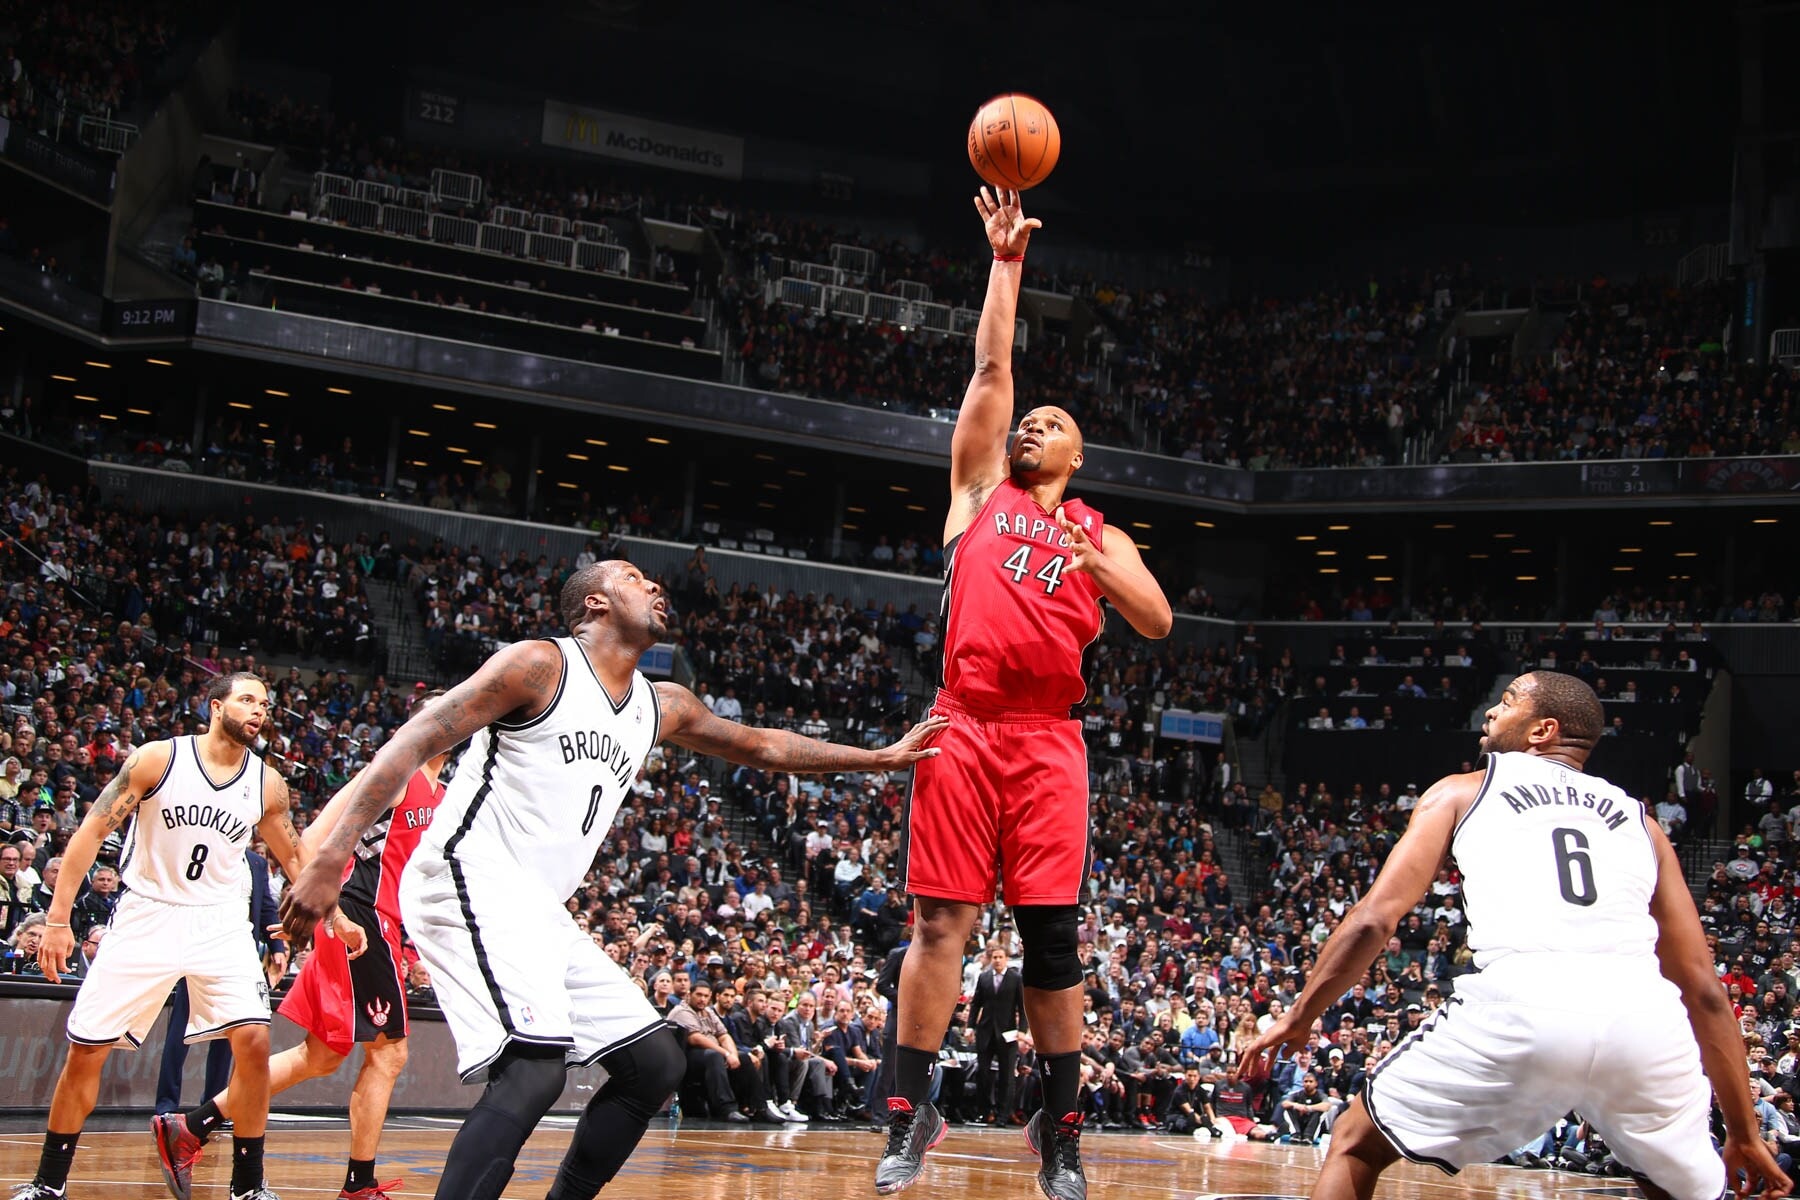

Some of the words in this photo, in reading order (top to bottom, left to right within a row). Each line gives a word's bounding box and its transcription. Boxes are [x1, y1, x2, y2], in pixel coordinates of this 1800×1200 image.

[420, 102, 455, 123] 212
[606, 127, 724, 168] McDonald's
[121, 310, 151, 325] 9:12
[153, 309, 175, 324] PM
[1631, 465, 1640, 477] 2
[994, 511, 1070, 549] RAPTO
[1000, 543, 1066, 597] 44
[161, 804, 248, 843] BROOKLYN
[582, 784, 602, 836] 0
[1500, 784, 1629, 831] ANDERSON
[186, 843, 209, 881] 8
[1551, 827, 1598, 907] 6
